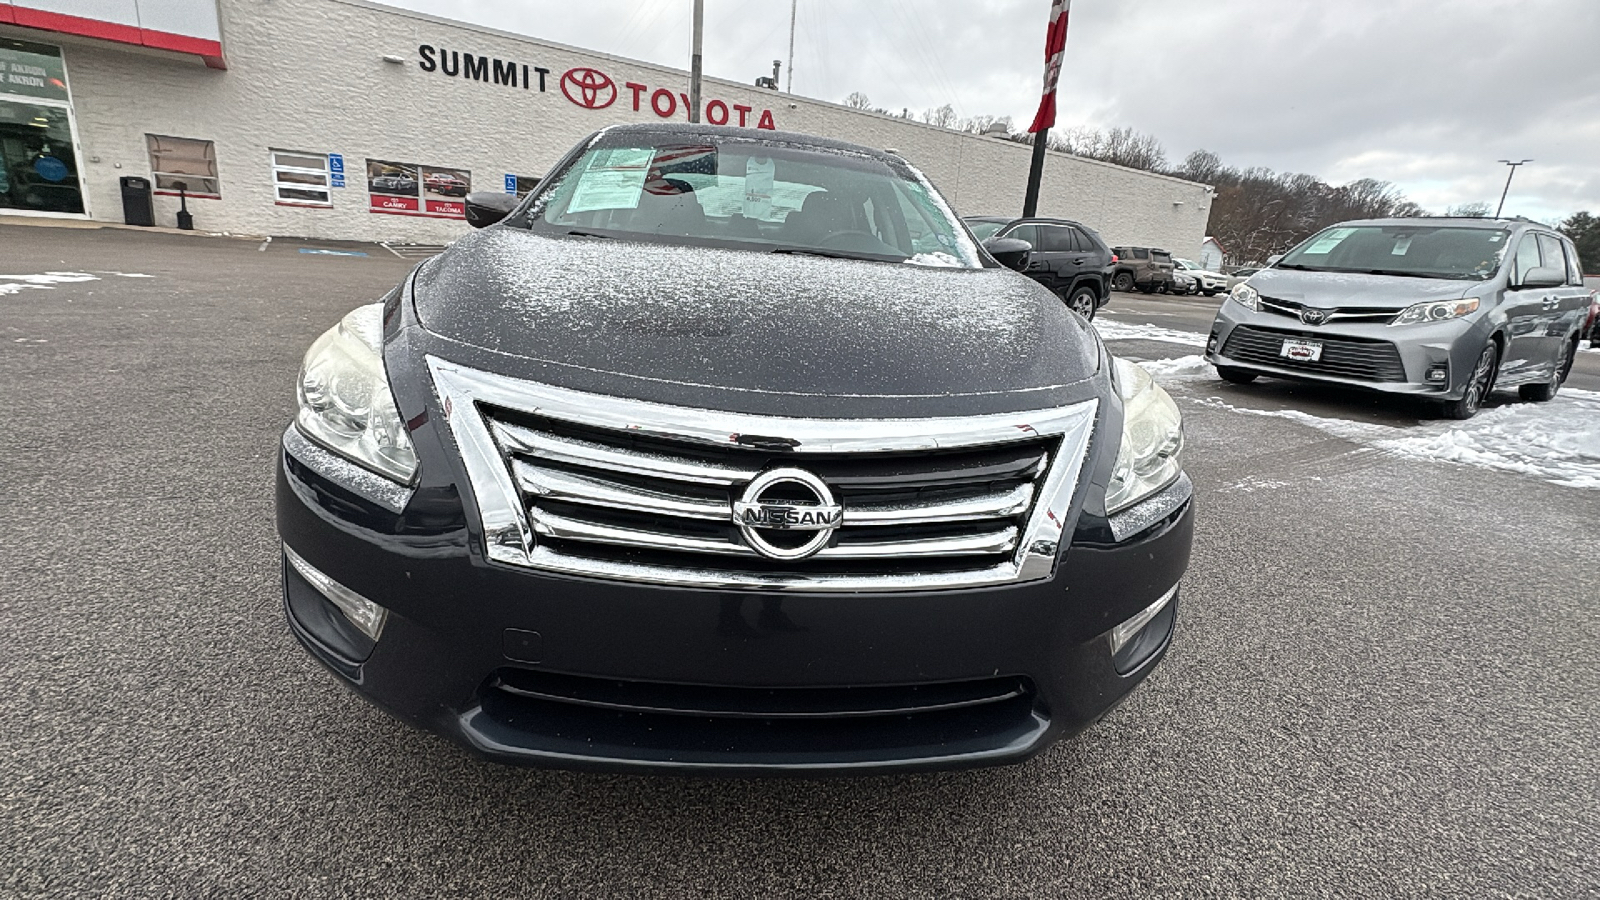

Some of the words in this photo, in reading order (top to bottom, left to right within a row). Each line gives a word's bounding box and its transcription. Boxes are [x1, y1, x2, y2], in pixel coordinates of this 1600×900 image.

[418, 44, 550, 93] SUMMIT
[8, 74, 45, 88] AKRON
[383, 201, 407, 209] CAMRY
[435, 206, 462, 214] TACOMA
[746, 508, 831, 525] NISSAN
